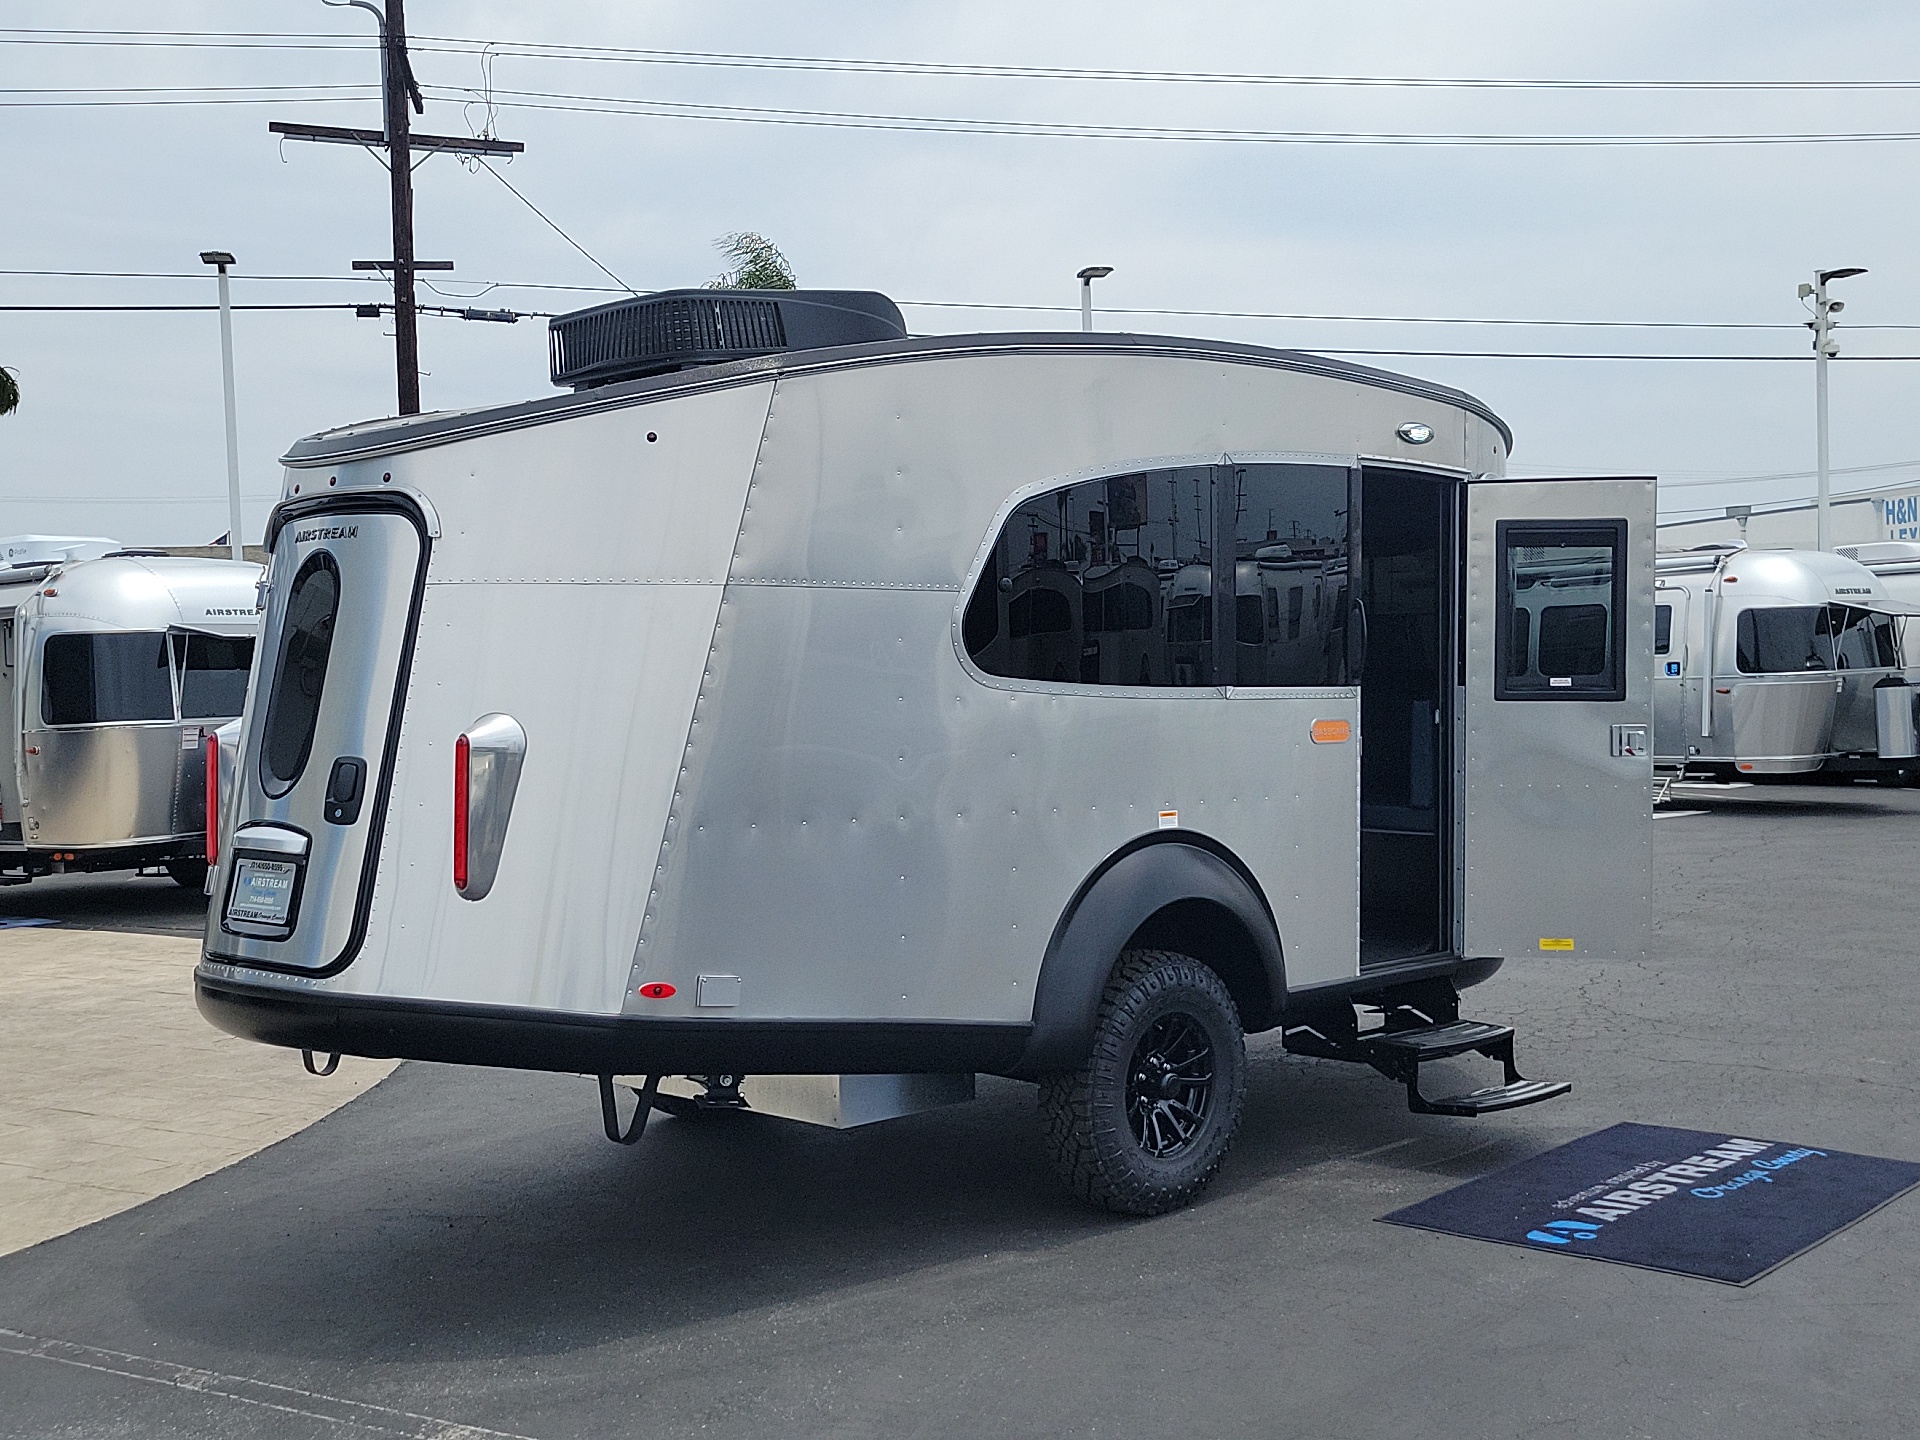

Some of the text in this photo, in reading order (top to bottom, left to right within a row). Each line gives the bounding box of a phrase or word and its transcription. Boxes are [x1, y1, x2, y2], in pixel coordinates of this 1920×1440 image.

[1885, 496, 1917, 525] H&N
[294, 526, 358, 543] AIRSTREAM
[205, 608, 261, 616] AIRSTREA
[251, 878, 288, 888] AIRSTREAM
[228, 908, 258, 918] AIRSTREAM
[1575, 1138, 1775, 1223] AIRSTREAM
[1690, 1147, 1828, 1199] Orange County
